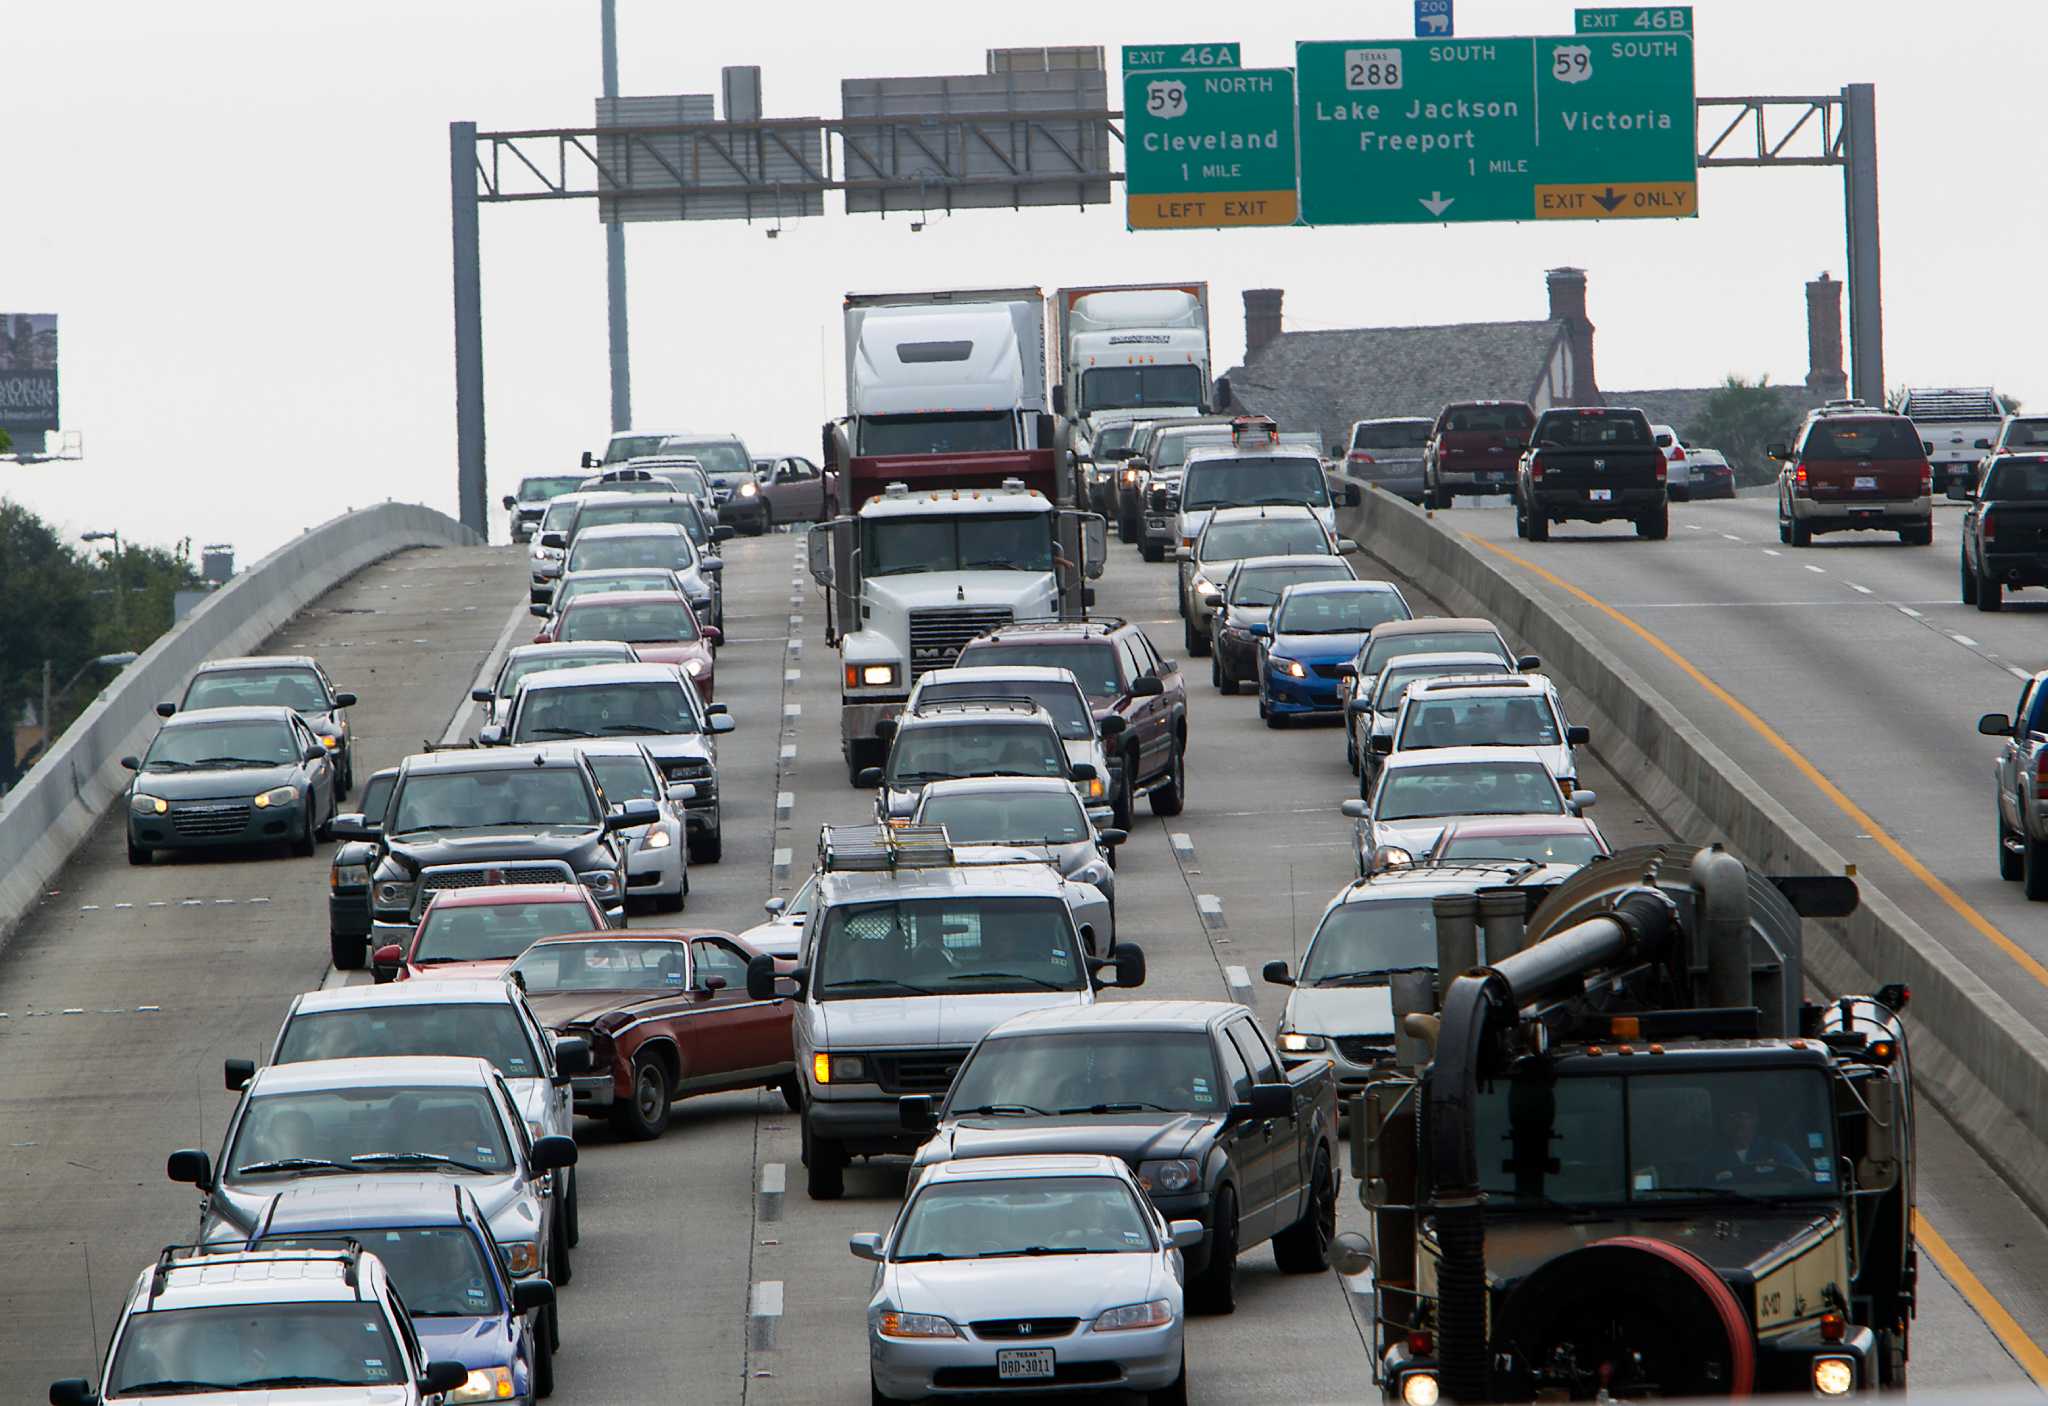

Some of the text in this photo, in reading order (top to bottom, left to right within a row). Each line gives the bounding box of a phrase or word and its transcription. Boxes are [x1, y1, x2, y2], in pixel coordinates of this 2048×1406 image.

[1420, 1, 1448, 12] ZOO
[1582, 10, 1685, 29] EXIT 46B
[1128, 47, 1233, 65] EXIT 46A
[1360, 52, 1388, 61] TEXAS
[1429, 45, 1496, 62] SOUTH
[1611, 41, 1678, 57] SOUTH
[1557, 53, 1588, 74] 59
[1351, 63, 1399, 86] 288
[1205, 77, 1273, 93] NORTH
[1151, 88, 1183, 110] 59
[1316, 98, 1519, 120] Lake Jackson
[1562, 110, 1672, 131] Victoria
[1143, 129, 1278, 151] Cleveland
[1360, 130, 1475, 153] Freeport
[1181, 163, 1241, 181] 1 MILE
[1468, 157, 1528, 176] 1 MILE
[1157, 200, 1267, 219] LEFT EXIT
[1543, 191, 1686, 209] EXIT ONLY
